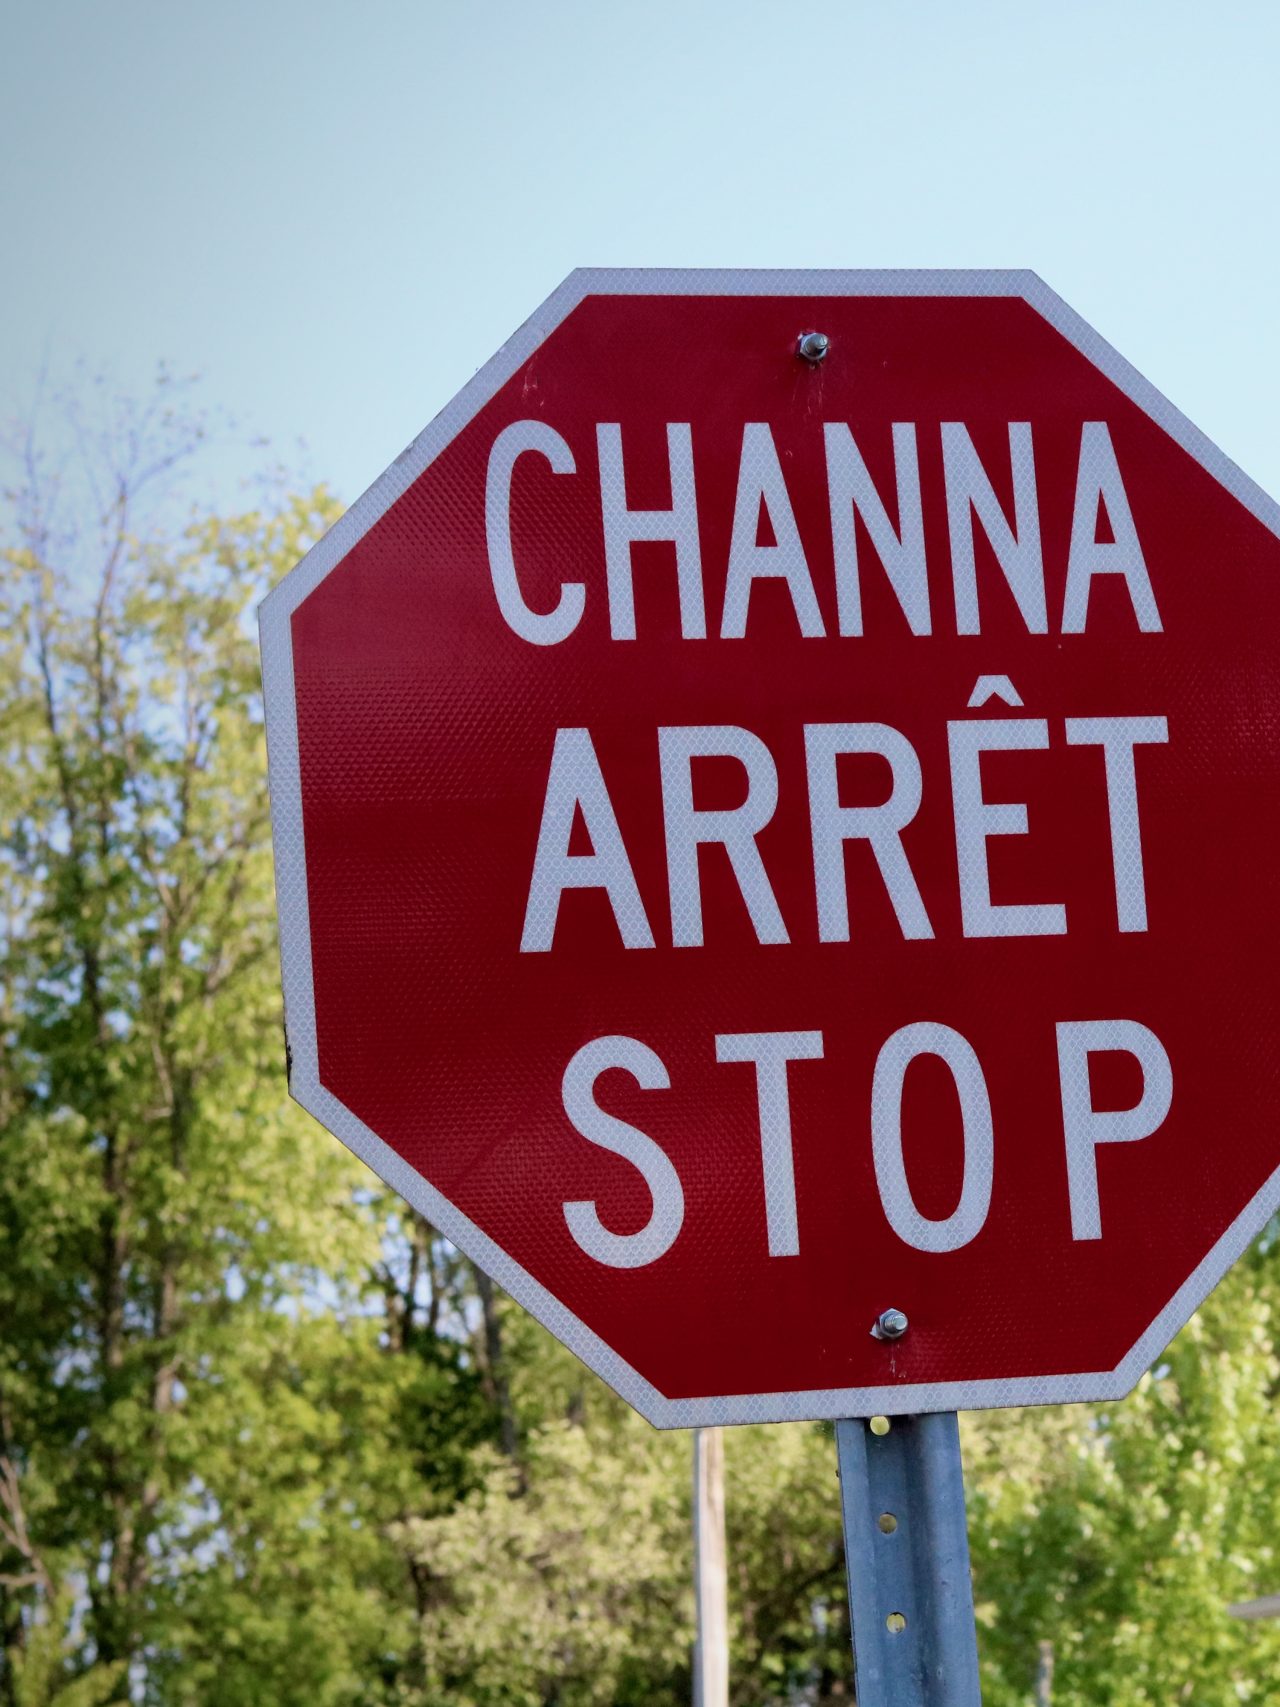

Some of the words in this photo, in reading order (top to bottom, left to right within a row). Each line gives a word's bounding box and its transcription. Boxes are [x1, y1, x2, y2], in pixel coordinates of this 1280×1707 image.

[484, 419, 1165, 647] CHANNA
[519, 674, 1170, 954] ARRÊT
[561, 1019, 1174, 1269] STOP
